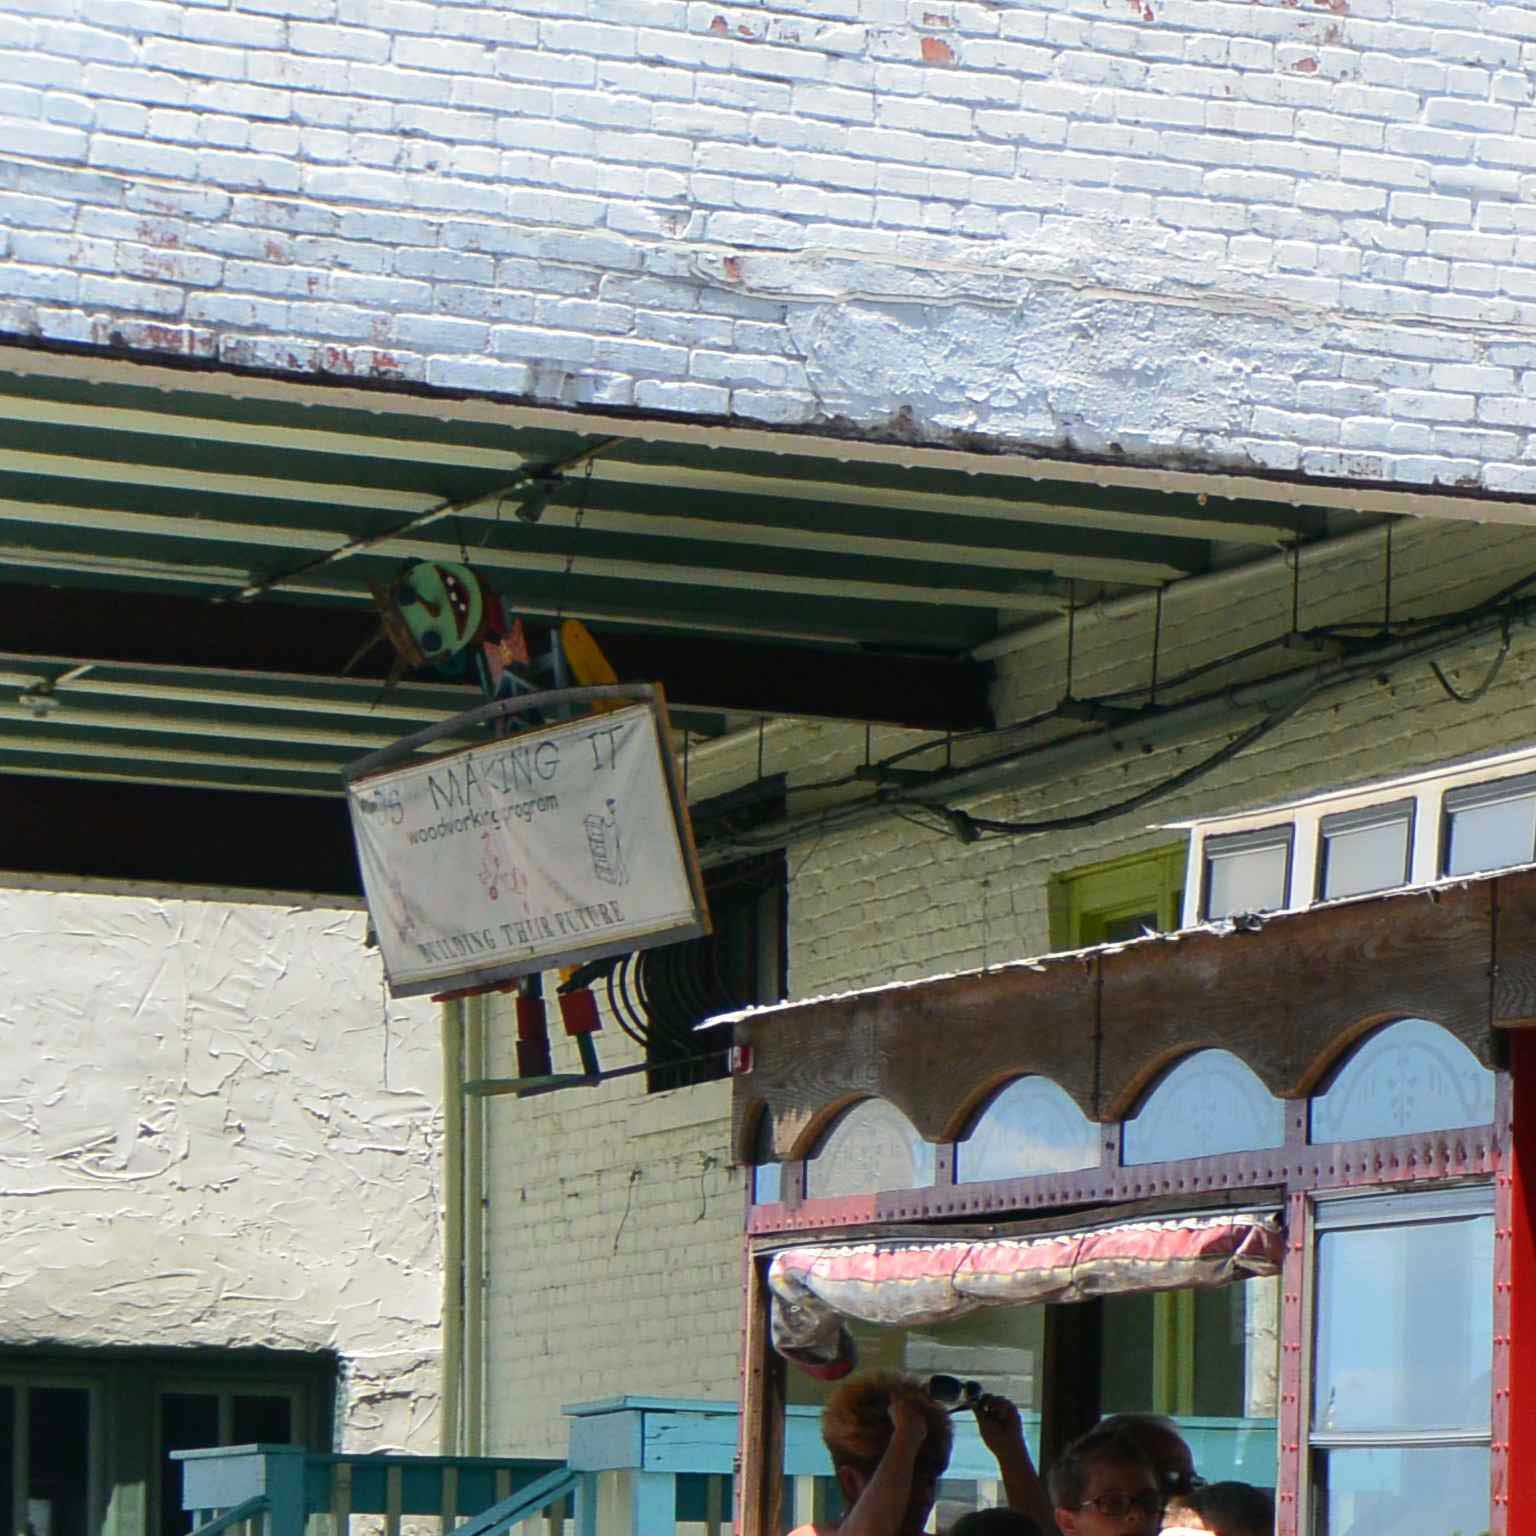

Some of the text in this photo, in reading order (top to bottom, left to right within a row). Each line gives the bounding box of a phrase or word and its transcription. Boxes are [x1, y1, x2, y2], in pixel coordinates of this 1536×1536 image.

[428, 725, 625, 812] MAKING IT
[555, 900, 626, 936] FUTURE
